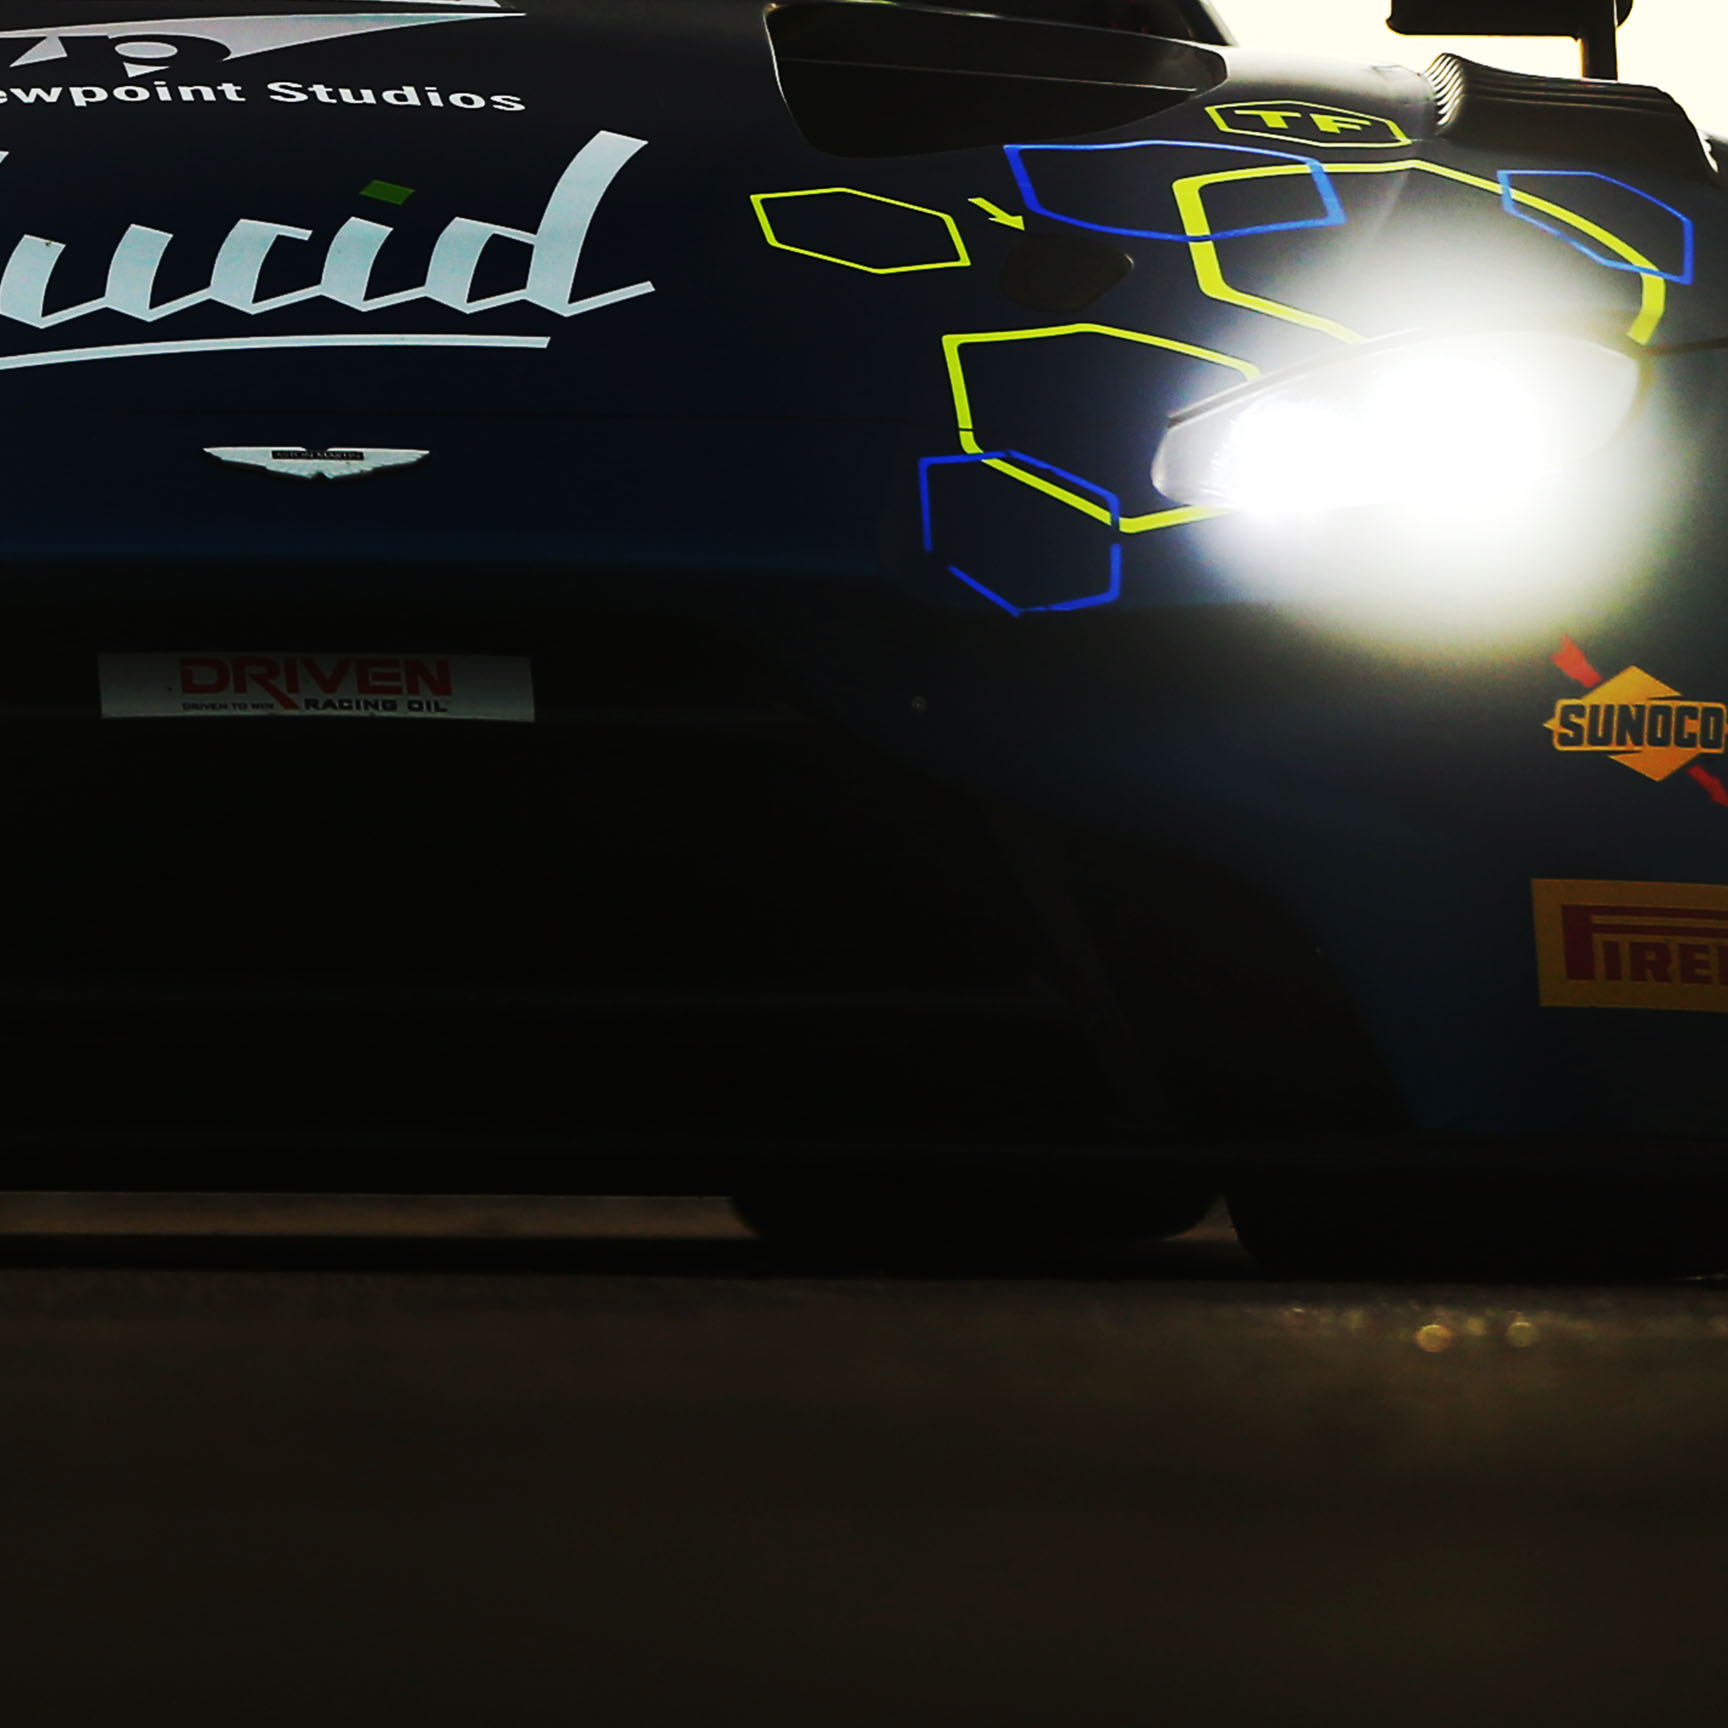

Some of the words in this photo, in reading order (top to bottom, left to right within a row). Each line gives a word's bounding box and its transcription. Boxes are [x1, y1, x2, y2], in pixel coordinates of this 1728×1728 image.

[267, 80, 528, 112] Studios
[1233, 108, 1373, 135] TF
[179, 656, 454, 711] DRIVEN
[303, 698, 398, 712] RACING
[406, 699, 449, 713] OIL
[1556, 702, 1726, 751] SUNOCO
